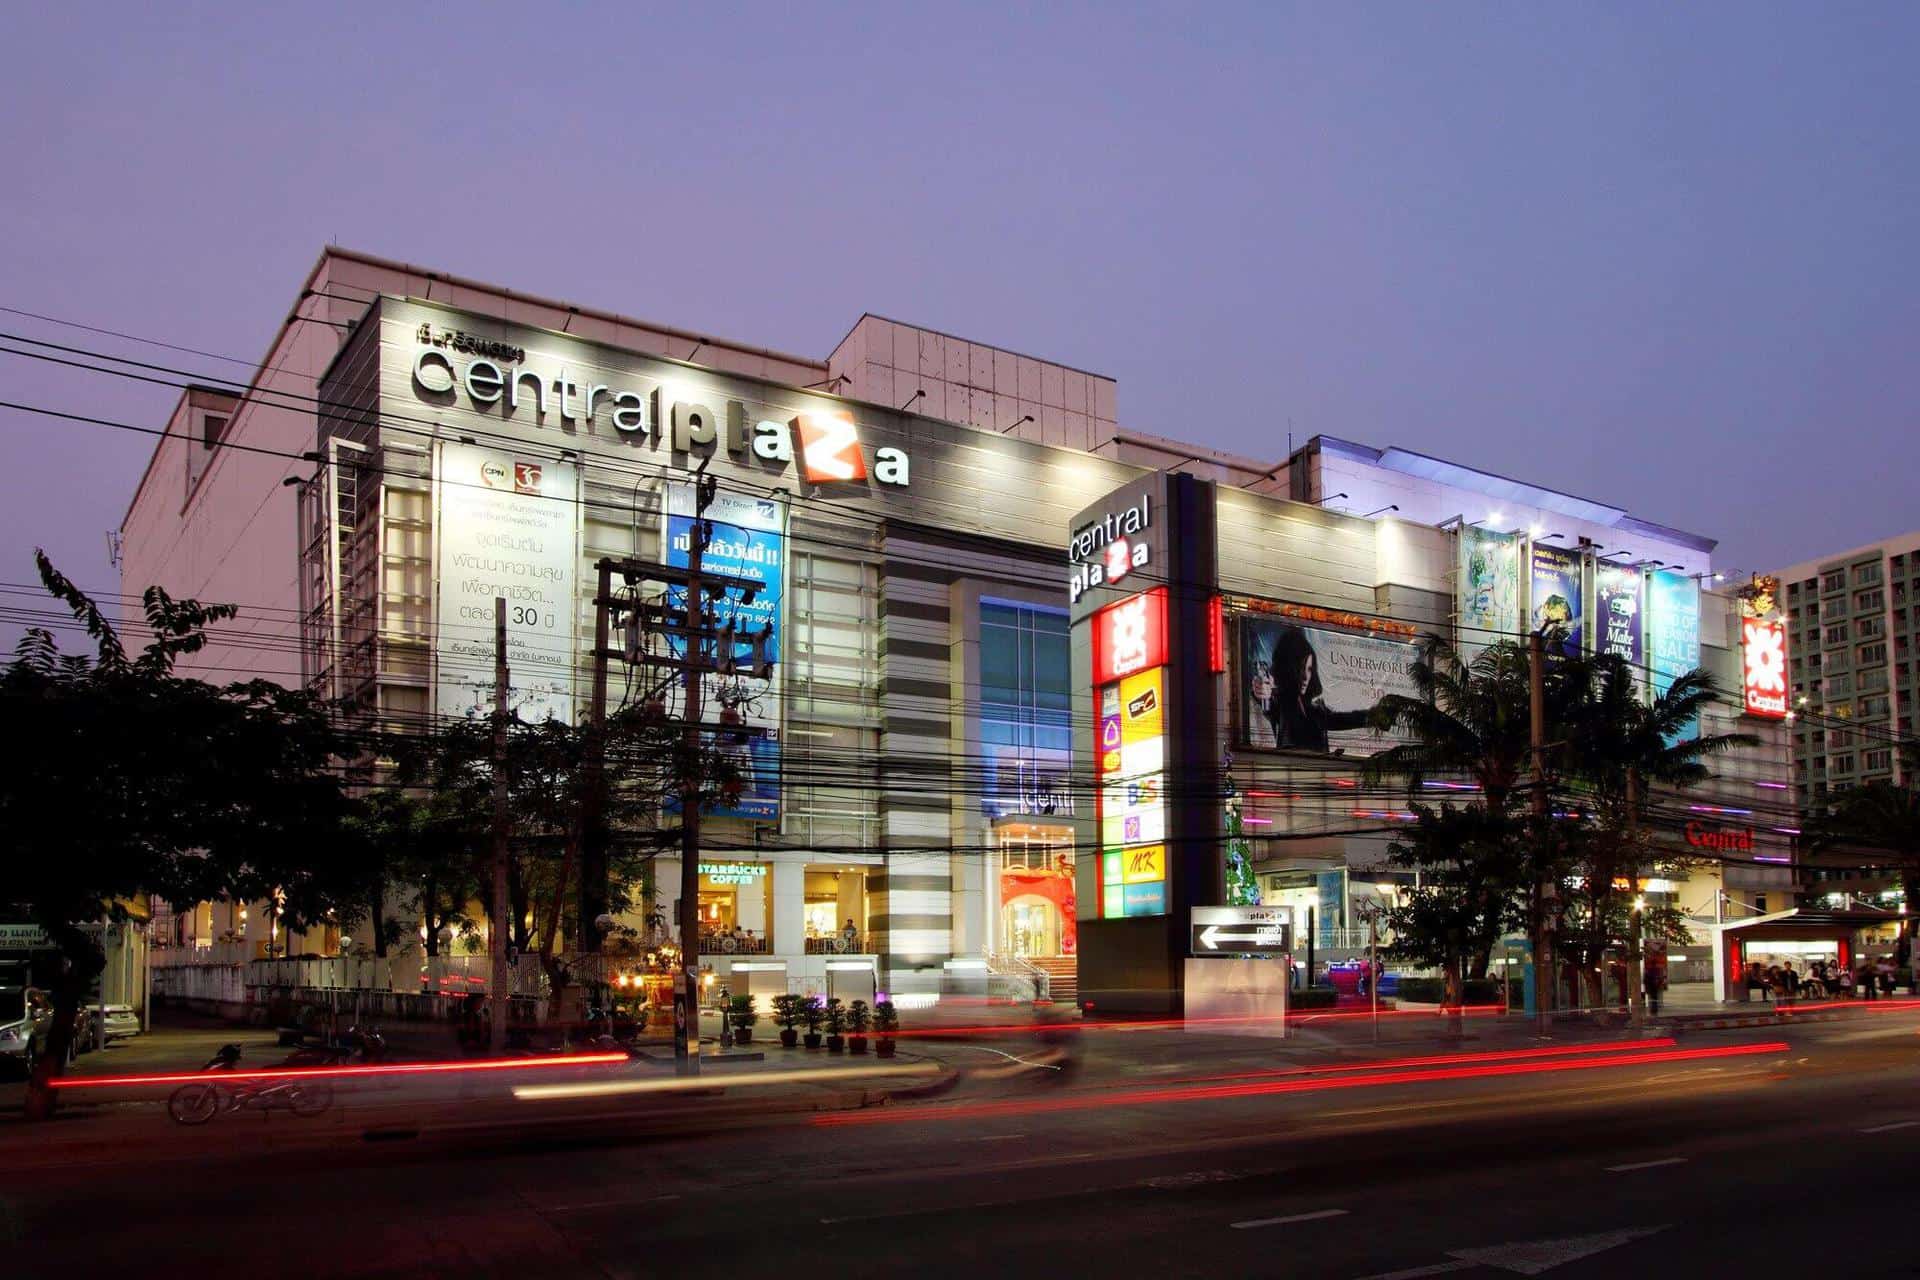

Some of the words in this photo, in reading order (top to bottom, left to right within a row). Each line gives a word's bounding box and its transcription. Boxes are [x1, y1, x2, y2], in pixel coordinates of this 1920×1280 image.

[1070, 494, 1149, 562] central
[513, 606, 538, 626] 30
[1130, 850, 1157, 873] MK
